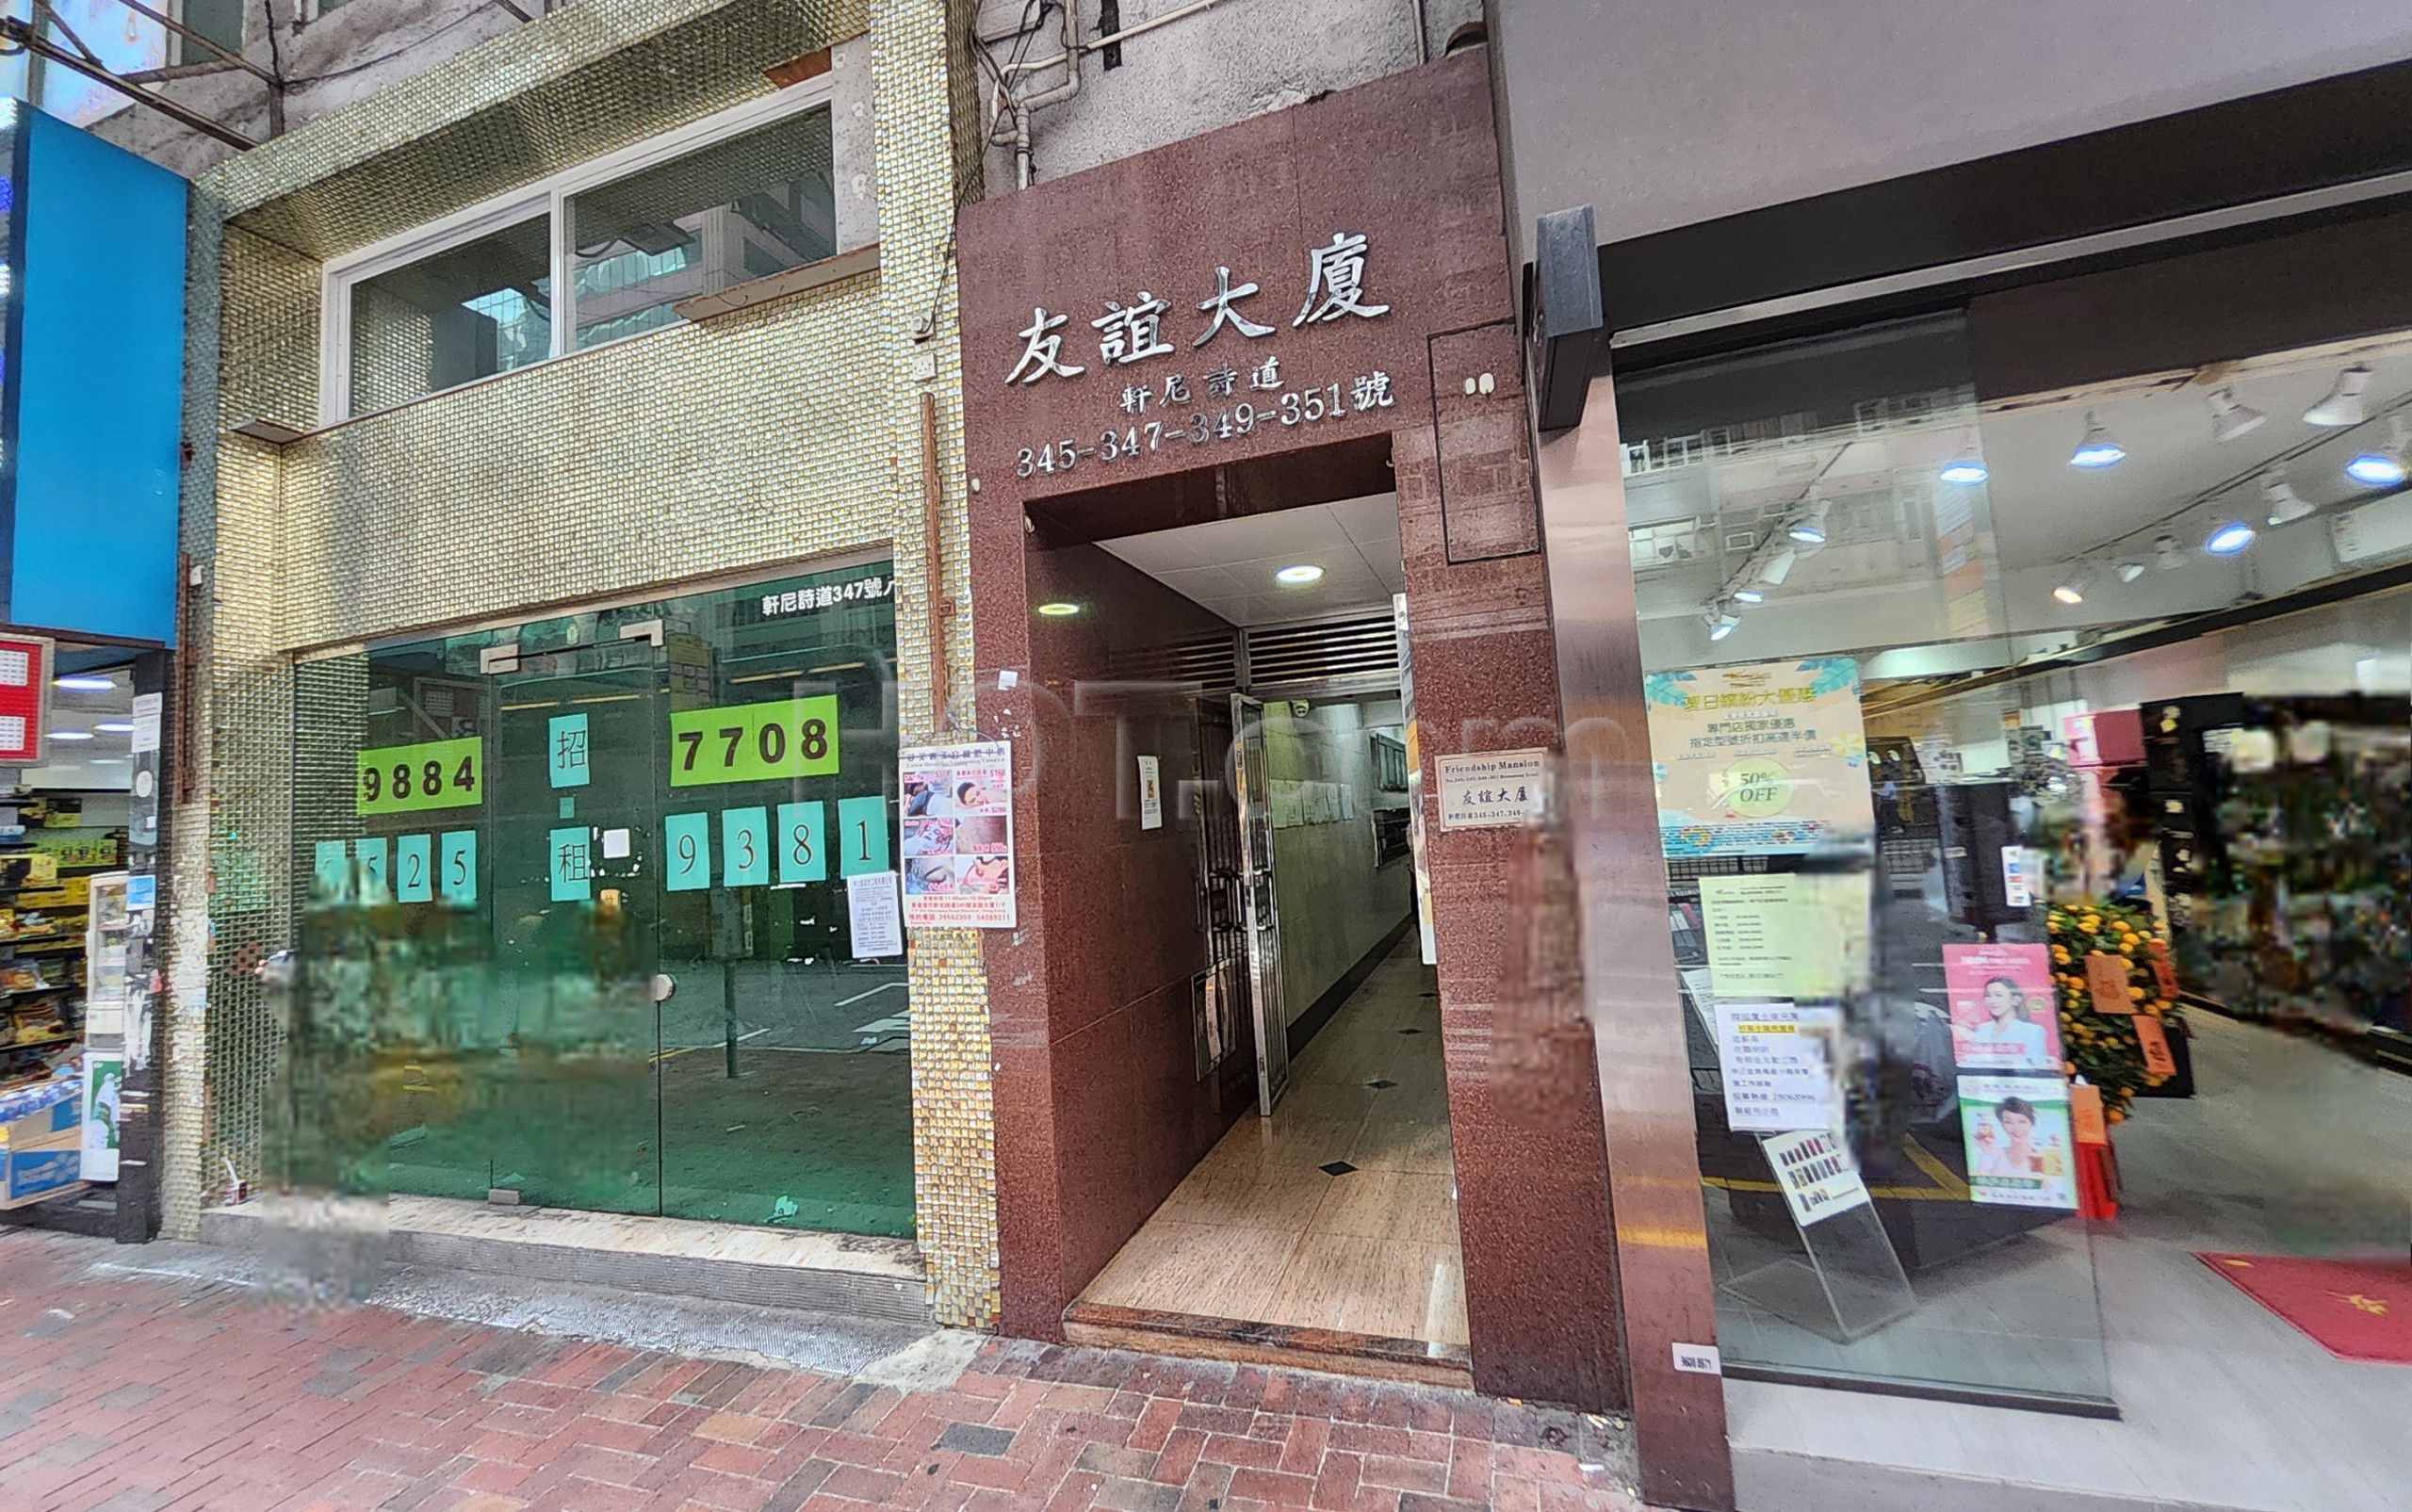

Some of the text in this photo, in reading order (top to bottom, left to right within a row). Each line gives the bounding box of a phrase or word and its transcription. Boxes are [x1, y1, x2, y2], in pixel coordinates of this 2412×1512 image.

[1004, 232, 1391, 386] 友誼大廈
[1119, 356, 1286, 415] 軒尼詩道
[1016, 371, 1396, 479] 345-347-349-351號
[677, 718, 828, 772] 7708
[1444, 759, 1540, 773] Friendship Mansion
[362, 755, 476, 803] 9884
[556, 728, 590, 884] 招租
[1739, 771, 1776, 787] 50%
[1739, 786, 1779, 803] OFF
[677, 817, 872, 876] 9381
